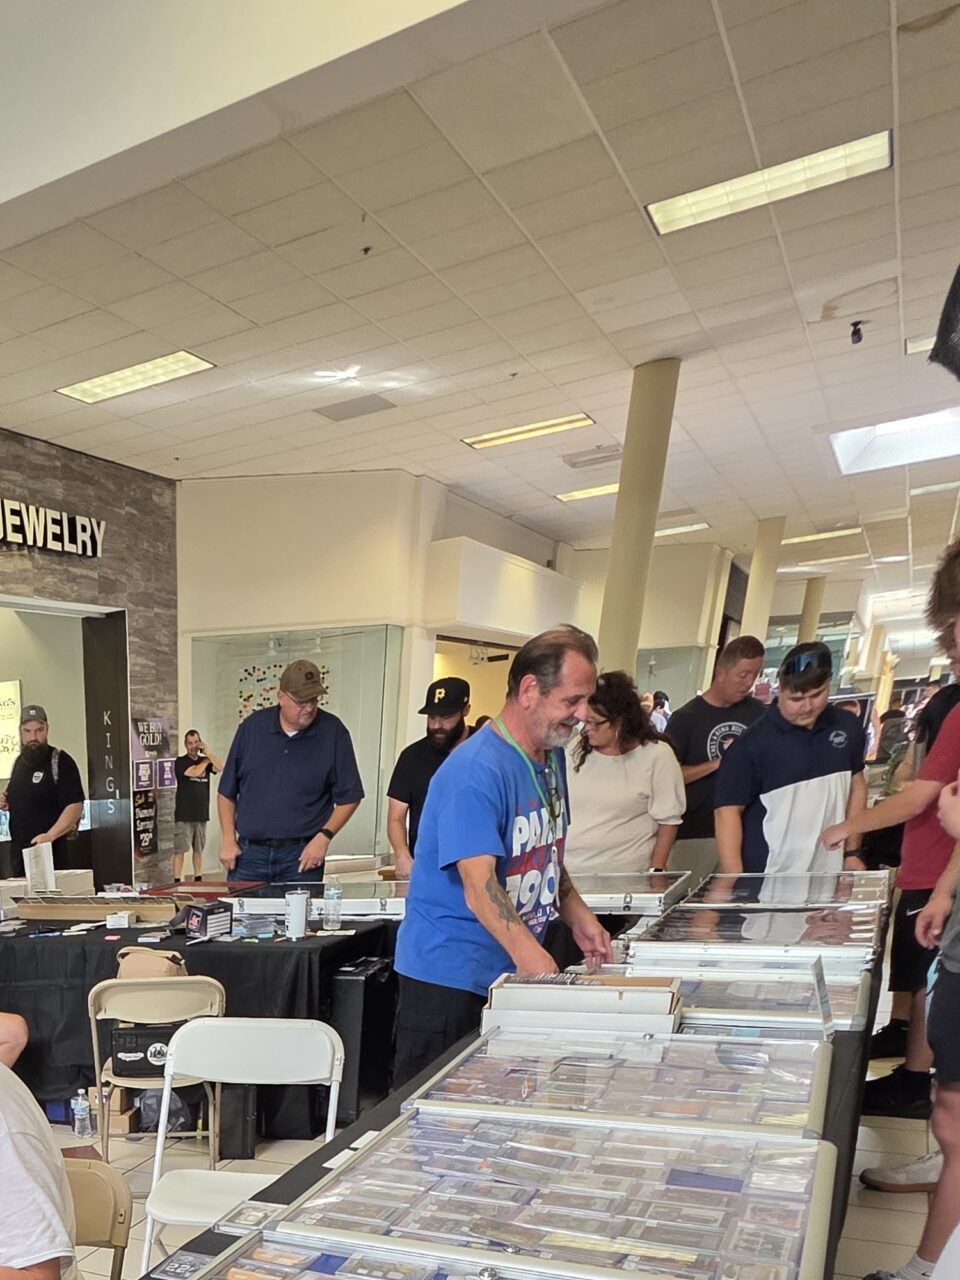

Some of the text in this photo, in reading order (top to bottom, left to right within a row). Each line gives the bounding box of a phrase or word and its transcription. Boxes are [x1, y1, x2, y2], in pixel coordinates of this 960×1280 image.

[434, 688, 446, 703] P
[138, 721, 162, 733] WE BUY
[139, 733, 162, 746] GOLD!
